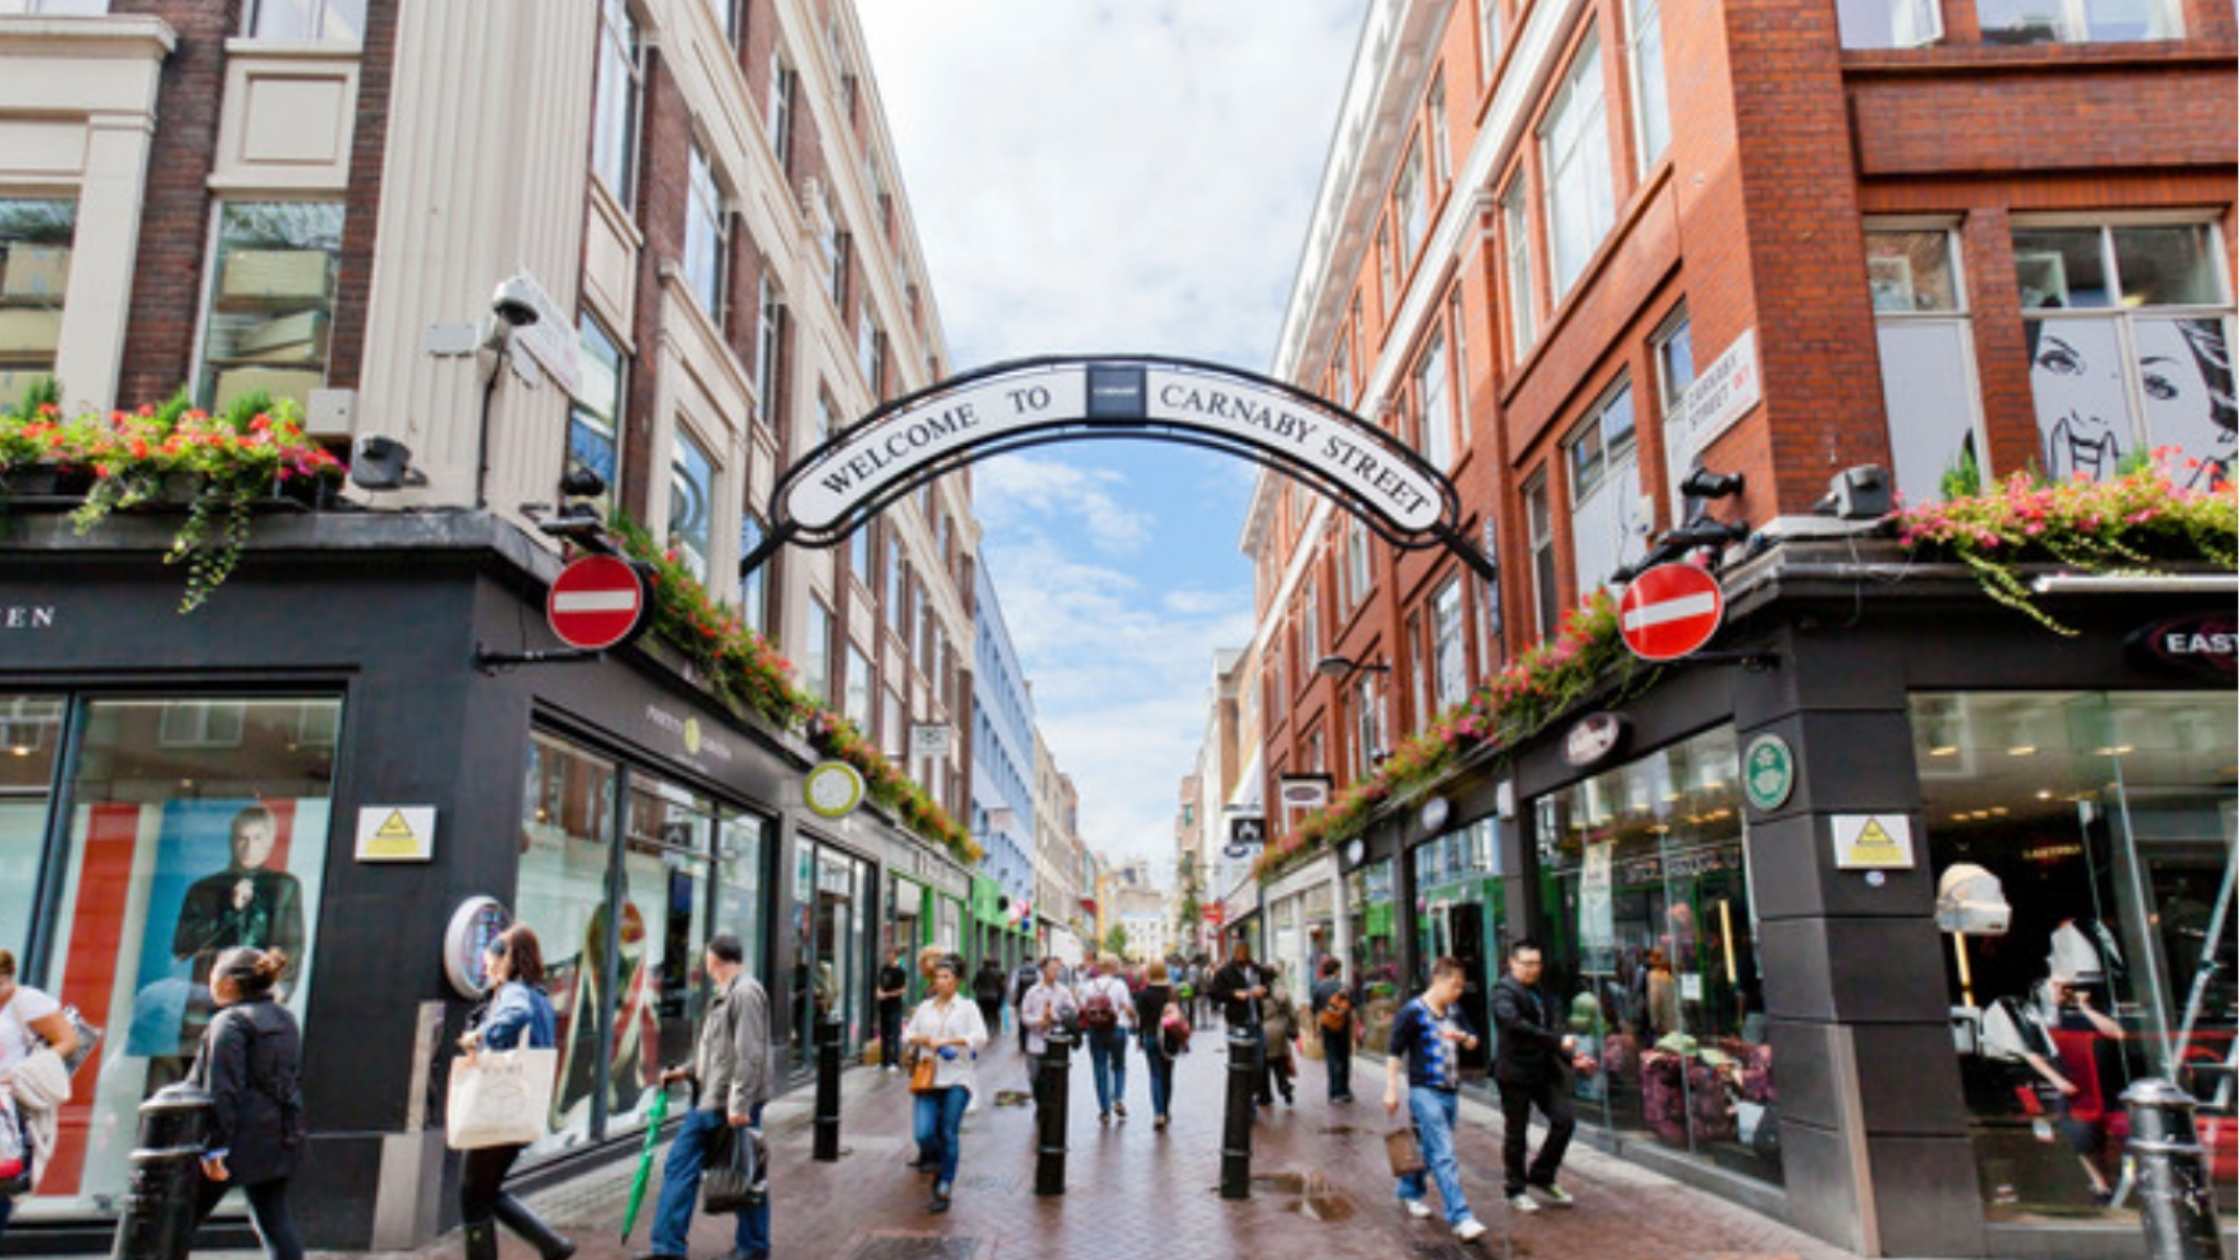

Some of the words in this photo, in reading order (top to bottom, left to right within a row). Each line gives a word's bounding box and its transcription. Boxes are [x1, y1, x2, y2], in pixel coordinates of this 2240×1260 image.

[1688, 350, 1737, 410] CARNABY
[1689, 382, 1728, 431] STREET
[821, 402, 980, 494] WELCOME
[1005, 385, 1051, 414] TO
[1160, 384, 1320, 443] CARNABY
[1321, 435, 1430, 514] STREET
[0, 605, 56, 628] EN
